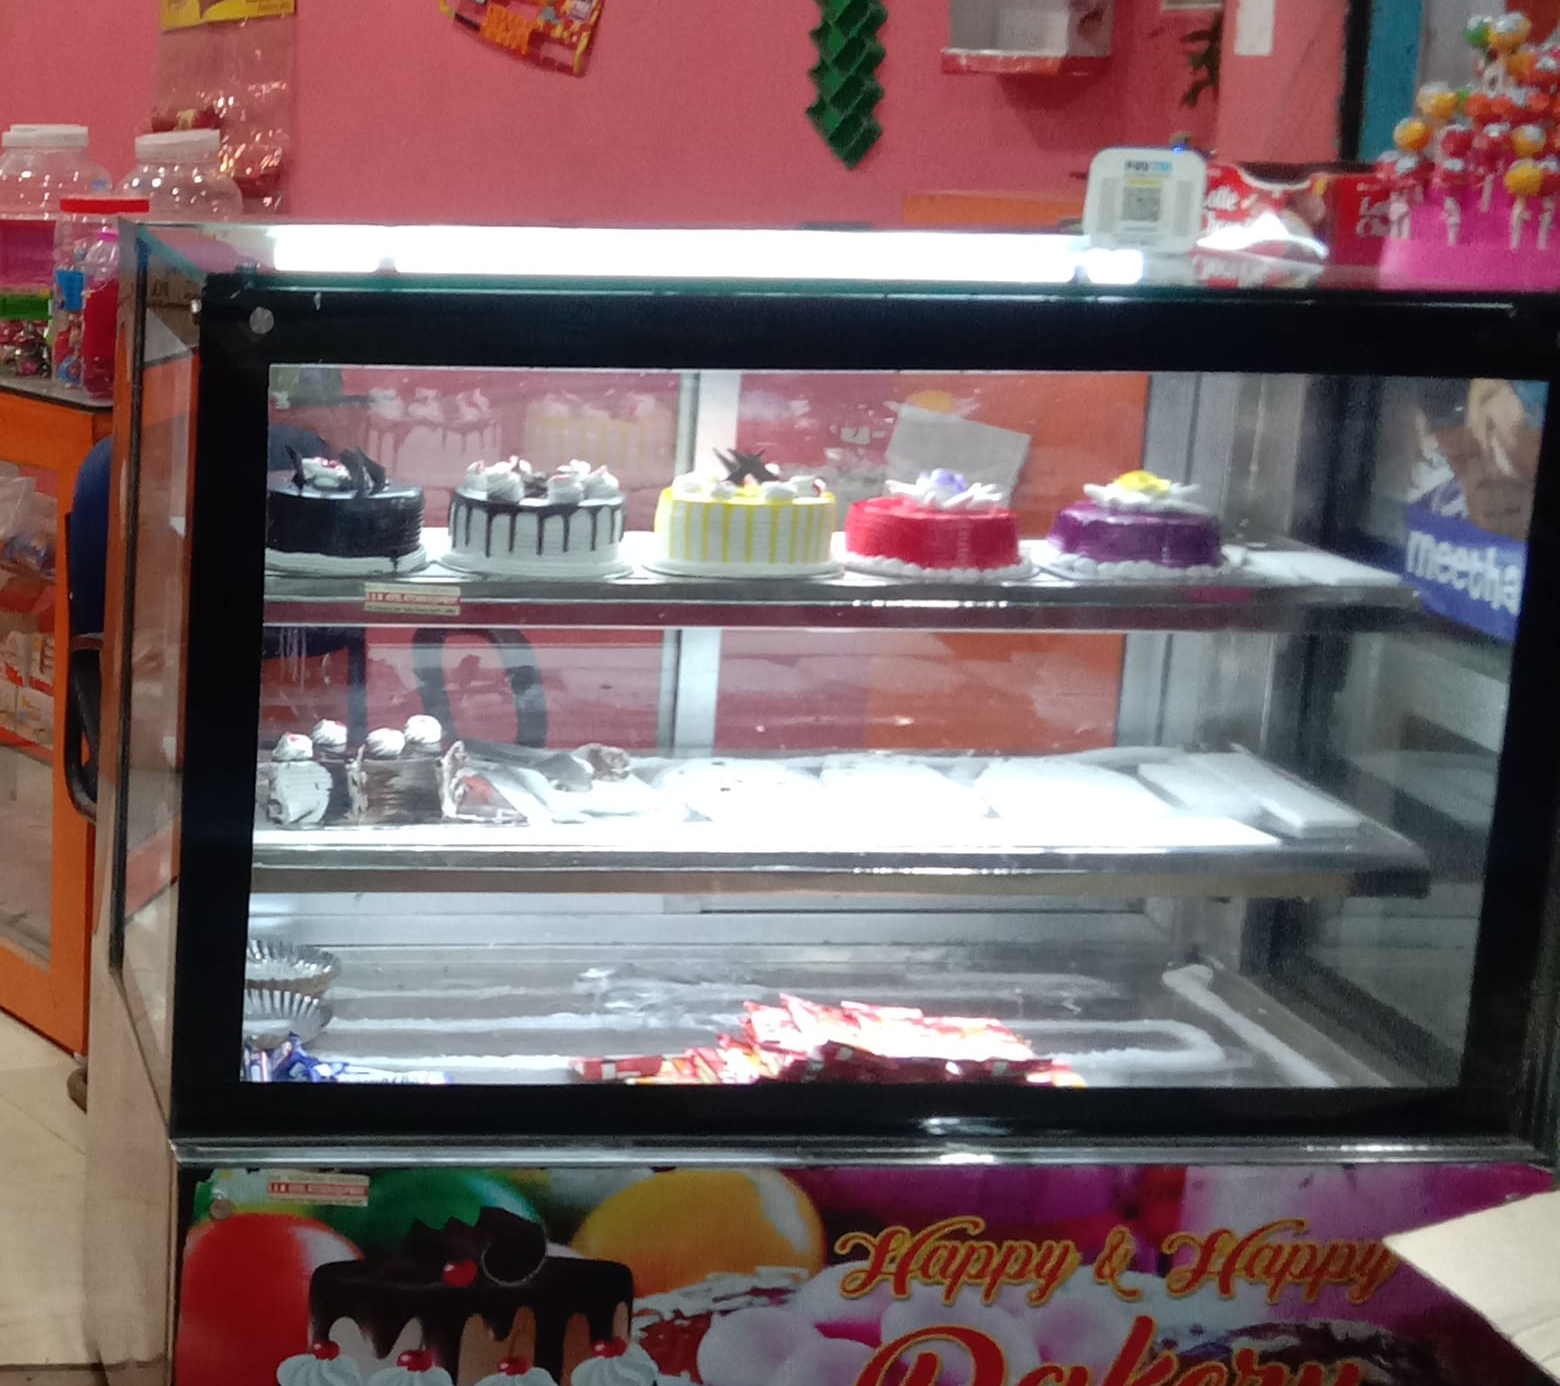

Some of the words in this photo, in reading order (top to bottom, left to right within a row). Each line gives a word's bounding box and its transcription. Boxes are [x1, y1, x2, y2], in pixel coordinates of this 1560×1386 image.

[834, 1215, 1083, 1305] Happy
[1094, 1225, 1144, 1302] &
[1163, 1216, 1400, 1305] Happy
